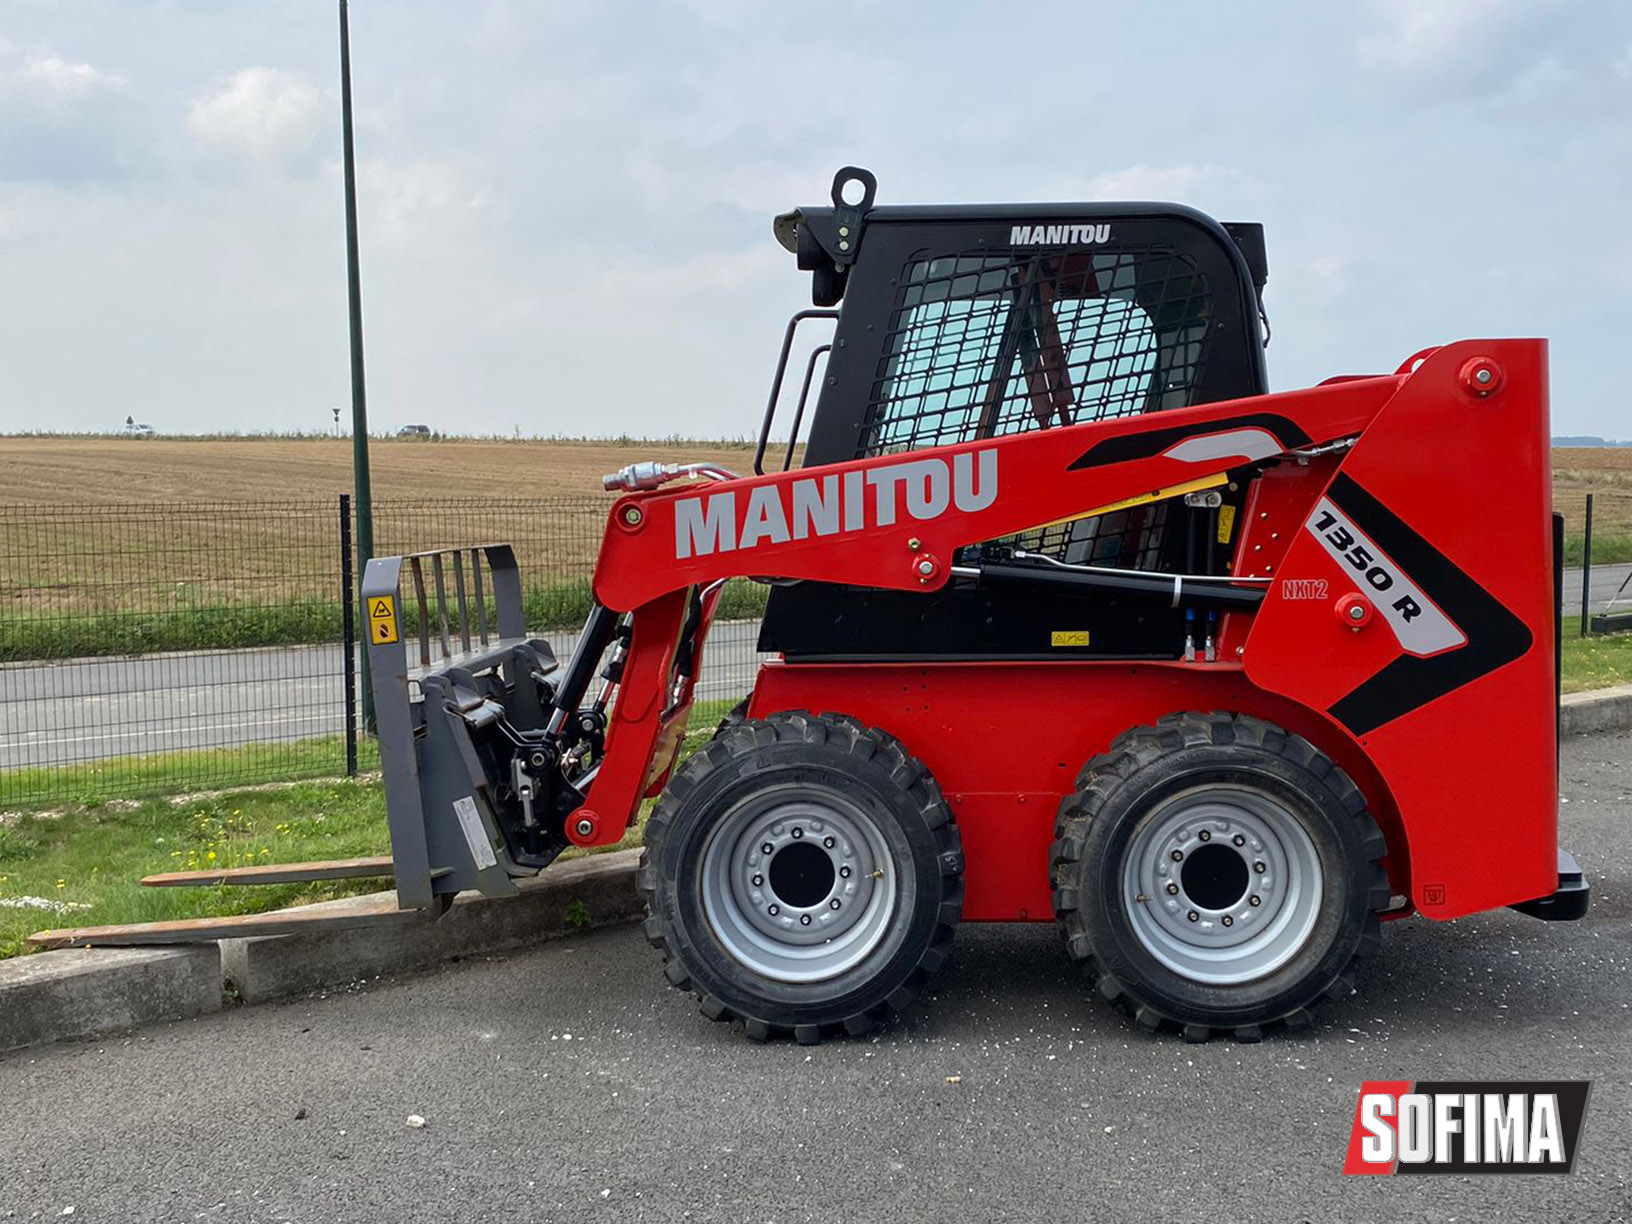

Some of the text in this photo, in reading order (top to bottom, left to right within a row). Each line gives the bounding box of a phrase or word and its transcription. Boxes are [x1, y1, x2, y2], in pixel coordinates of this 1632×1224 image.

[1010, 224, 1111, 245] MANITOU
[674, 448, 999, 560] MANITOU
[1282, 579, 1329, 600] NXT2
[1315, 510, 1422, 624] 1350 R
